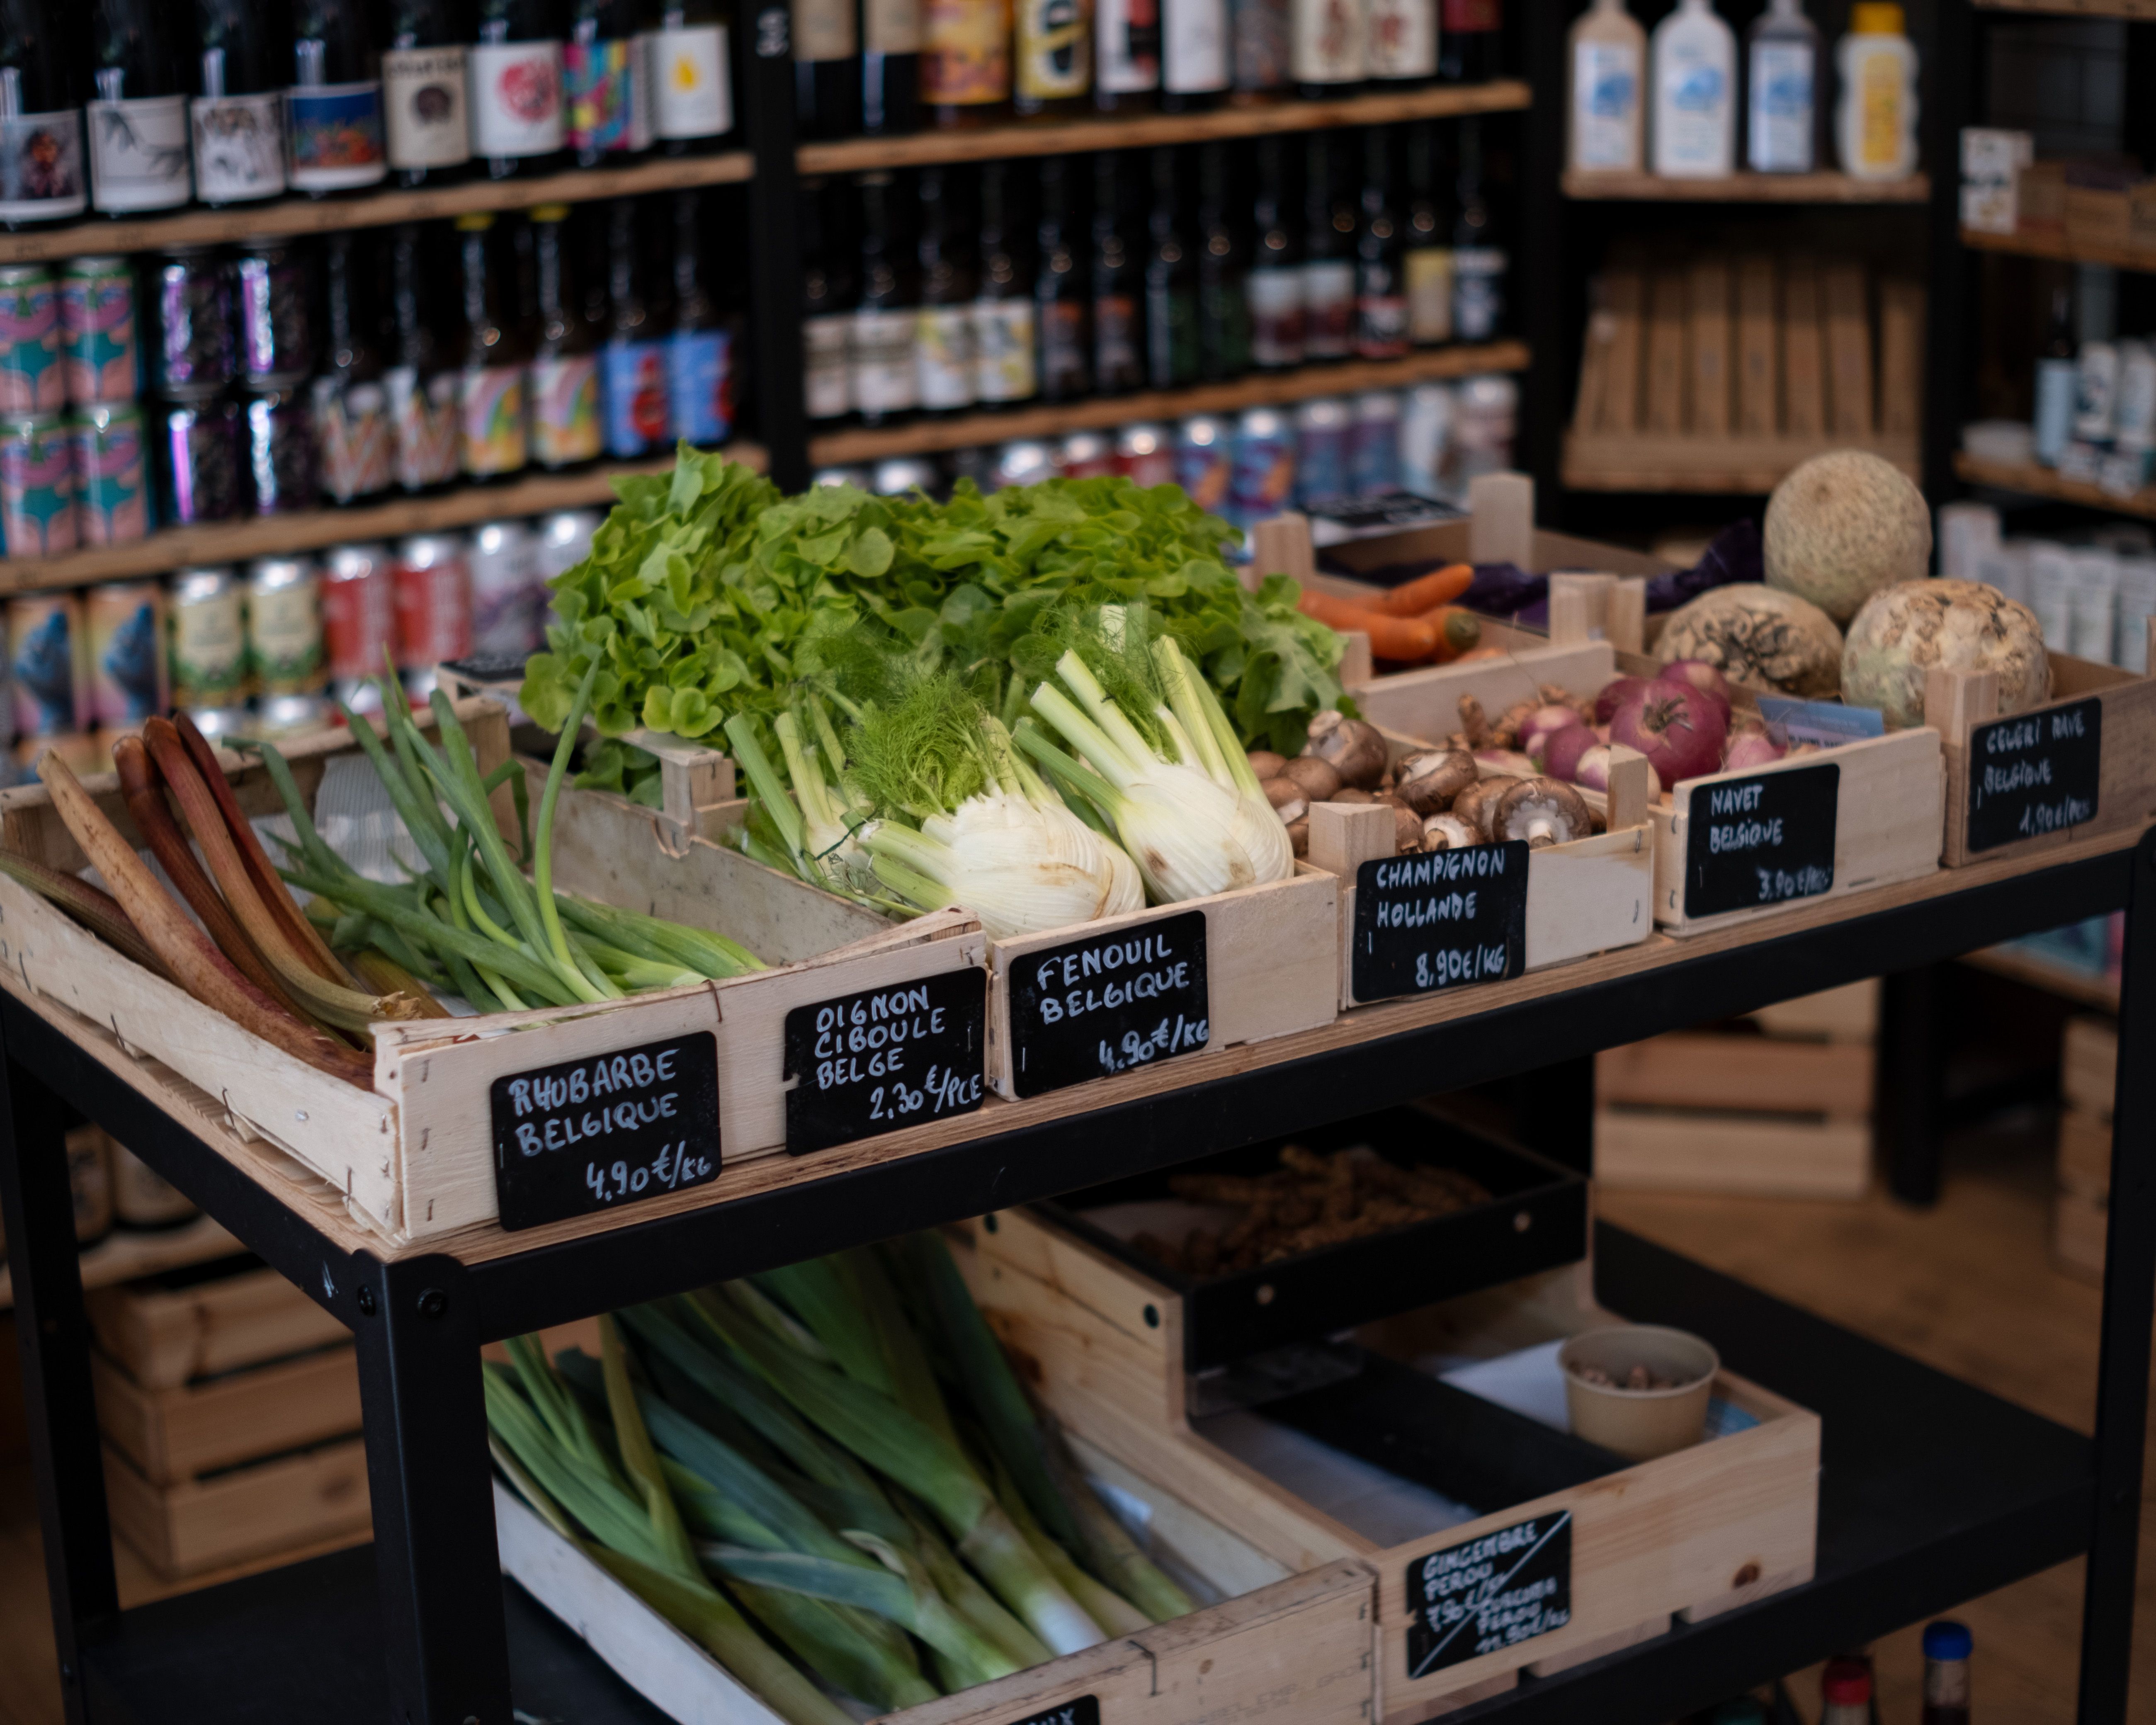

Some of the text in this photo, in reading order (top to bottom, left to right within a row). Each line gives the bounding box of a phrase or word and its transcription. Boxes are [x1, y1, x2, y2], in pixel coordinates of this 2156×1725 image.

[1711, 784, 1763, 816] NAVET
[1710, 818, 1783, 854] BELGIQUE
[1376, 848, 1505, 889] CHAMPIGNON
[1377, 891, 1477, 928] HOLLANDE
[1037, 934, 1172, 991] FENOUIL
[816, 985, 929, 1033] OIGNON
[1040, 962, 1189, 1025] BELGIQUE
[815, 1008, 946, 1058] CIBOULE
[508, 1048, 680, 1117] RHUBARBE
[816, 1048, 904, 1090] BELGE
[515, 1092, 679, 1157] BELGIQUE
[1423, 1521, 1537, 1580] GINGEMBRE
[1425, 1562, 1493, 1601] PEROU
